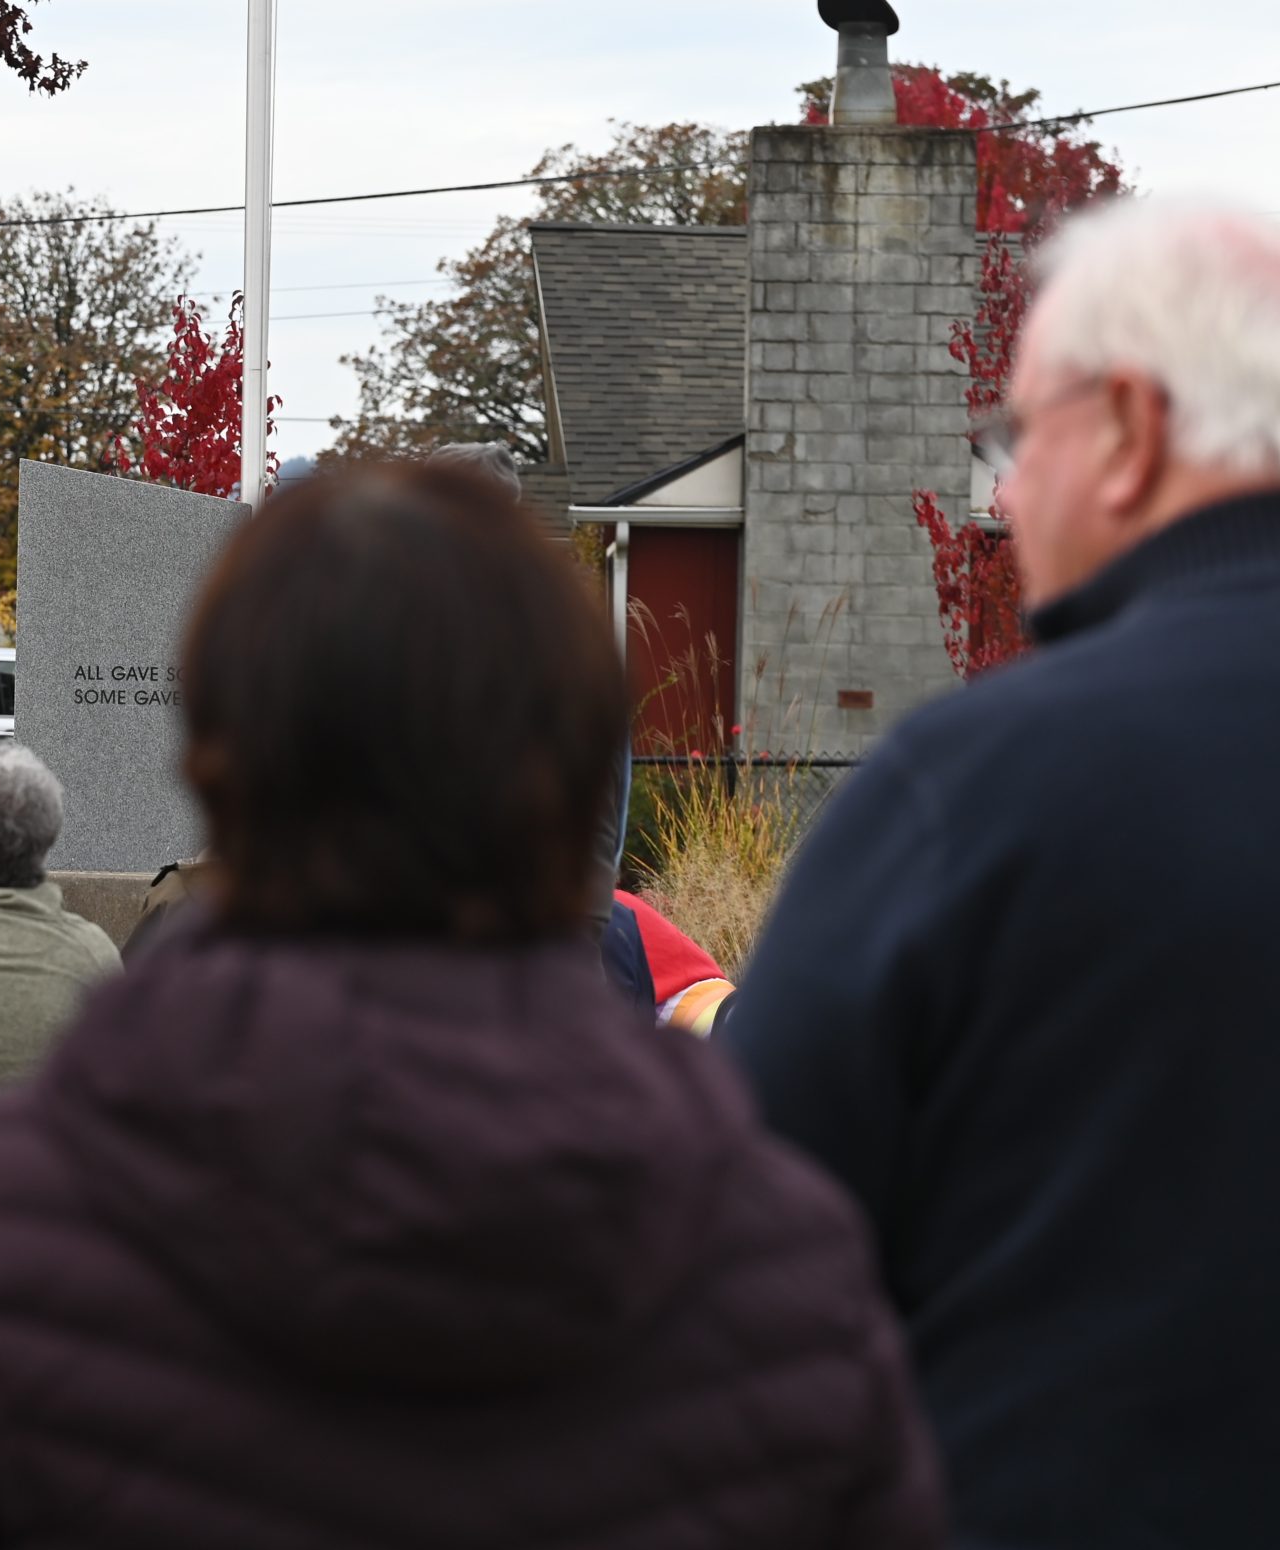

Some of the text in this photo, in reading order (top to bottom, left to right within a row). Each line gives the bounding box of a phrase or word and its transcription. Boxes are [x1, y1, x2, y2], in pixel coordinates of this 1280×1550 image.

[74, 665, 184, 682] ALL GAVE SO
[74, 689, 182, 706] SOME GAVE
